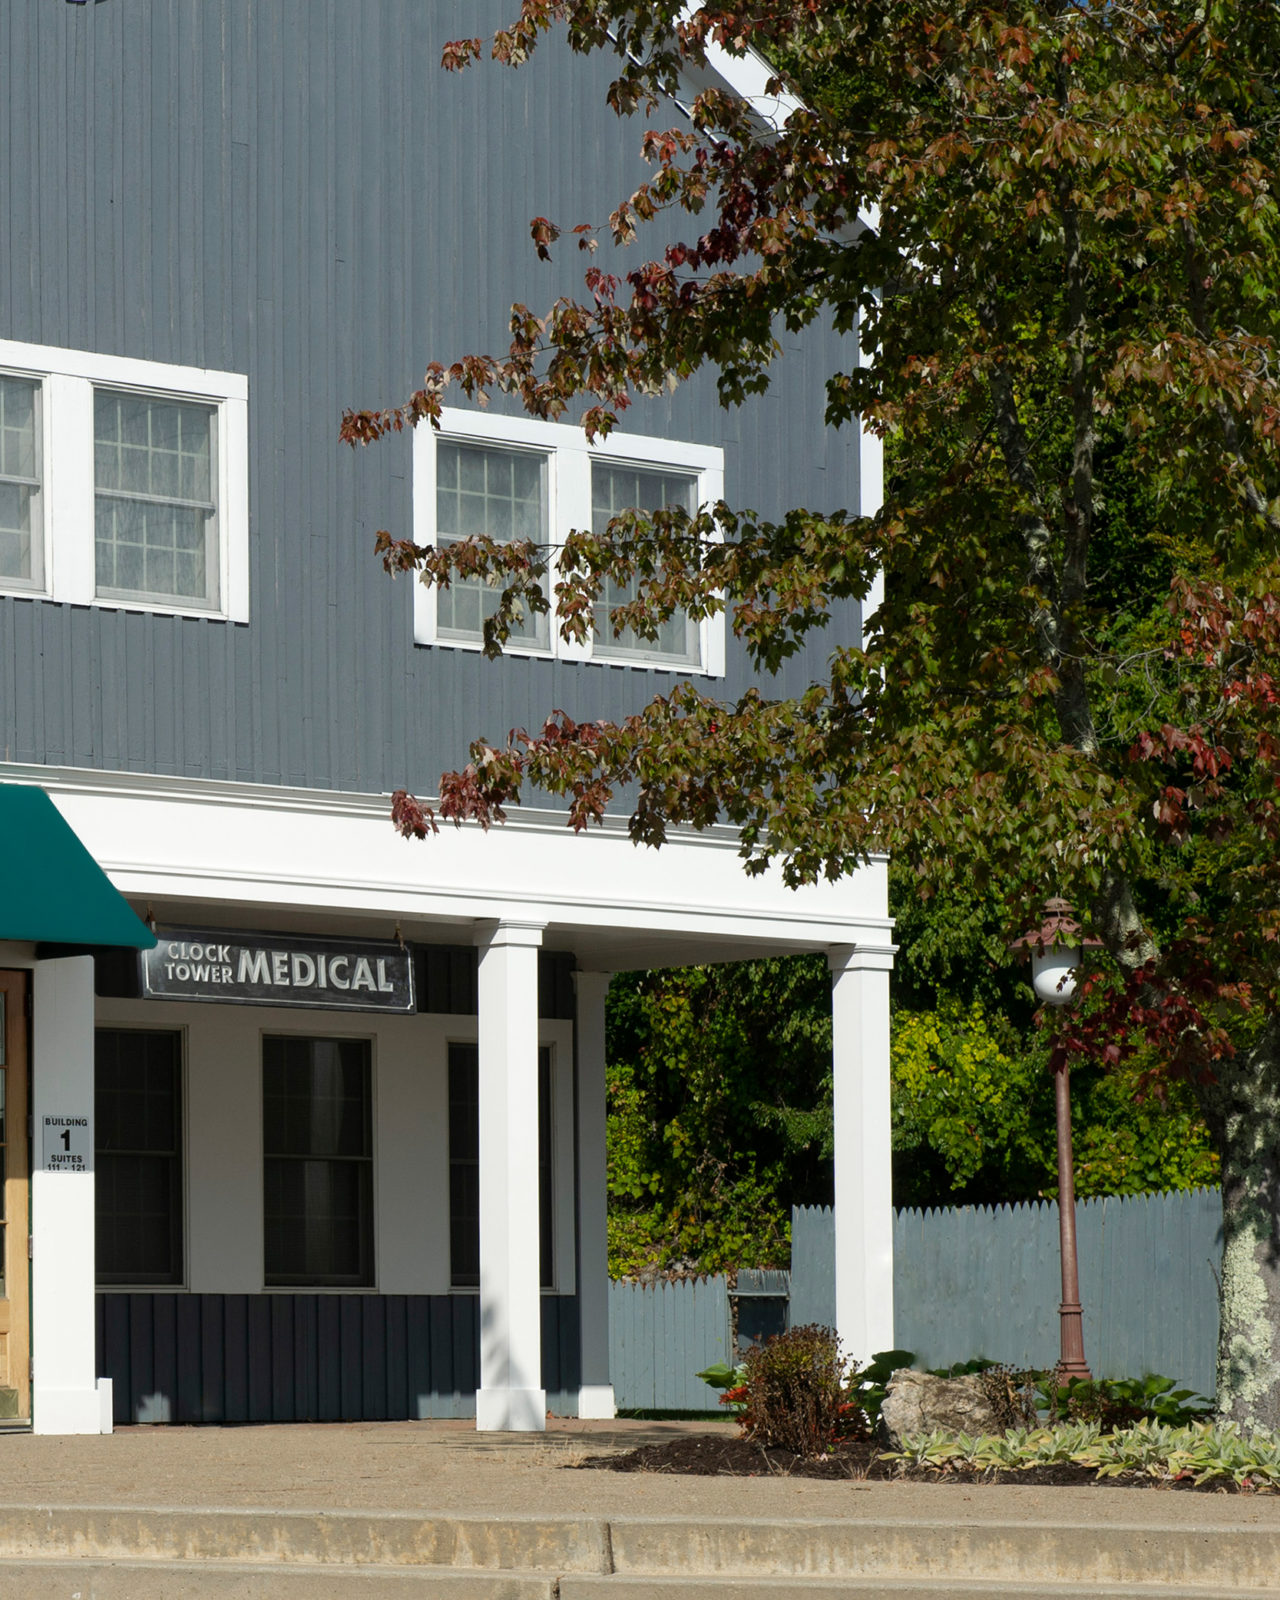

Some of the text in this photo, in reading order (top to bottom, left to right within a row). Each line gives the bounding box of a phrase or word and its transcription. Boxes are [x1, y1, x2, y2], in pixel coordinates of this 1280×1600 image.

[168, 942, 231, 963] CLOCK
[164, 962, 234, 984] TOWER
[237, 949, 394, 992] MEDICAL
[45, 1118, 88, 1126] BUILDING
[60, 1129, 70, 1151] 1
[51, 1155, 83, 1163] SUITES
